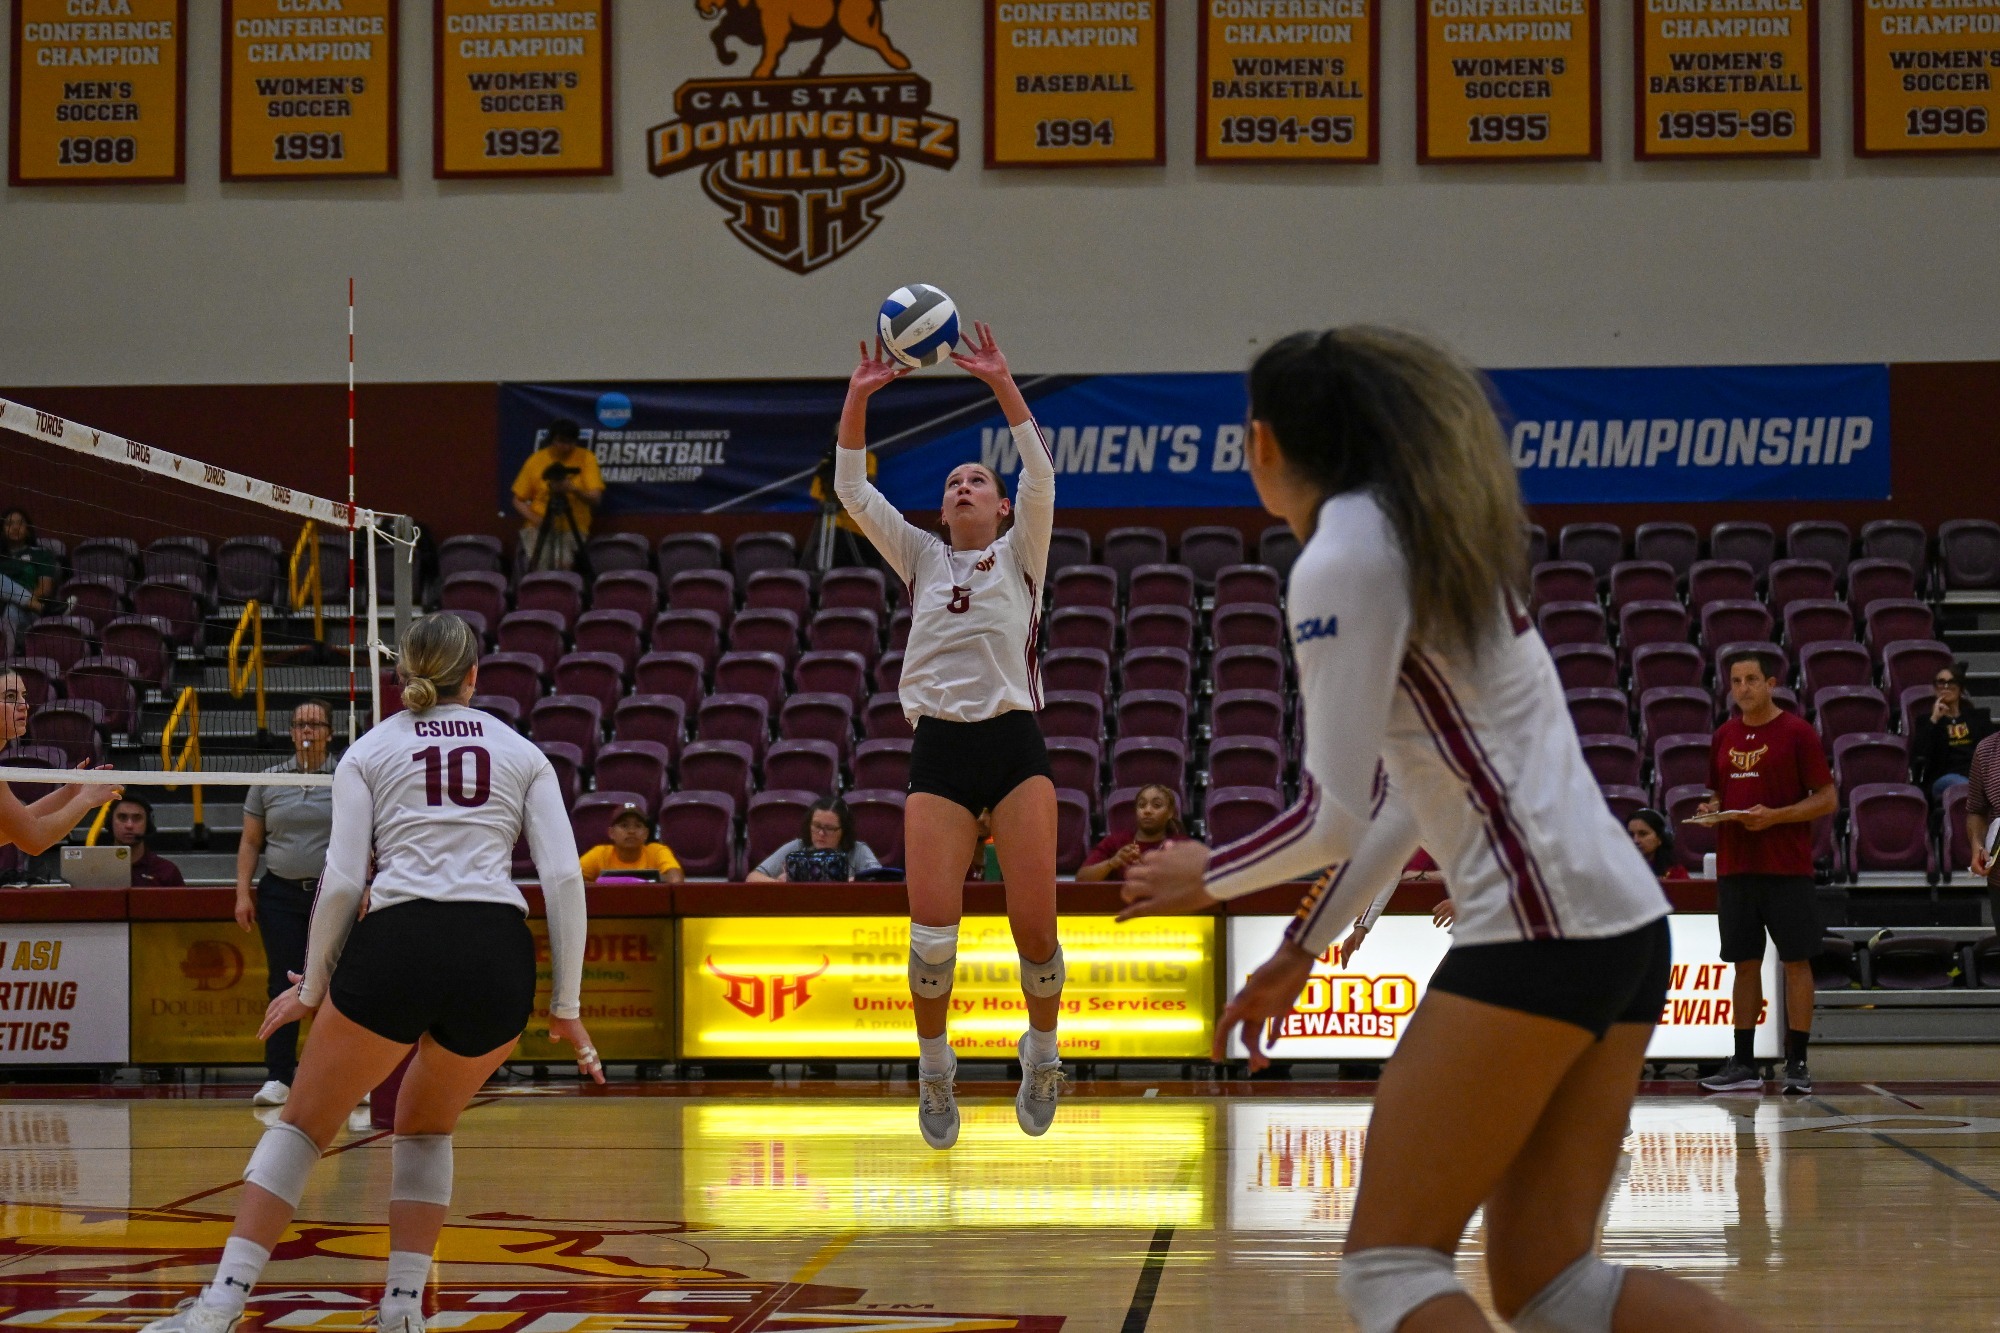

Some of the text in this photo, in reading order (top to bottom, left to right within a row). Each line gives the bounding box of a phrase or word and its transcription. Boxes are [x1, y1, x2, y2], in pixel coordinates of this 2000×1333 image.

[66, 0, 131, 16] CCAA
[1000, 2, 1150, 22] CONFERENCE
[1212, 0, 1365, 18] CONFERENCE
[1430, 0, 1584, 17] CONFERENCE
[25, 21, 173, 42] CONFERENCE
[236, 17, 385, 37] CONFERENCE
[447, 12, 597, 33] CONFERENCE
[1443, 21, 1572, 42] CHAMPION
[1661, 17, 1790, 38] CHAMPION
[1011, 27, 1139, 48] CHAMPION
[1224, 24, 1352, 43] CHAMPION
[37, 46, 160, 66] CHAMPION
[247, 42, 372, 62] CHAMPION
[459, 37, 585, 58] CHAMPION
[1232, 58, 1345, 76] WOMEN'S
[1452, 58, 1565, 76] WOMEN'S
[1669, 53, 1783, 70] WOMEN'S
[1890, 51, 2000, 69] WOMEN'S
[63, 82, 133, 99] MEN'S
[255, 77, 365, 96] WOMEN'S
[468, 72, 578, 91] WOMEN'S
[1015, 74, 1135, 93] BASEBALL
[1212, 81, 1363, 98] BASKETBALL
[1465, 81, 1552, 99] SOCCER
[1650, 75, 1803, 93] BASKETBALL
[1903, 73, 1990, 91] SOCCER
[480, 94, 564, 113] SOCCER
[690, 84, 918, 110] CAL STATE
[56, 104, 139, 121] SOCCER
[267, 99, 351, 117] SOCCER
[1221, 118, 1353, 143] 1994-95
[1469, 116, 1548, 141] 1995
[1659, 112, 1793, 139] 1995-96
[1907, 109, 1986, 135] 1996
[485, 129, 561, 157] 1992
[653, 109, 956, 166] DOMINGUEZ
[1036, 120, 1113, 147] 1994
[59, 138, 135, 164] 1988
[274, 134, 343, 160] 1991
[735, 146, 870, 180] HILLS
[36, 411, 64, 438] TOROS
[126, 440, 150, 464] TOROS
[595, 441, 725, 465] BASKETBALL
[980, 424, 1202, 475] WMEN'S
[1512, 416, 1873, 469] CHAMPIONSHIP
[203, 464, 226, 487] TOROS
[601, 466, 703, 482] HAMPIONSHIP
[946, 585, 972, 613] 5
[414, 720, 484, 737] CSUDH
[411, 745, 491, 808] 10
[12, 940, 62, 970] ASI
[585, 935, 656, 962] OTEL
[1694, 964, 1727, 990] AT
[853, 997, 1187, 1013] Univty Houg Services
[1293, 974, 1416, 1015] ORO
[580, 1004, 654, 1018] thletics
